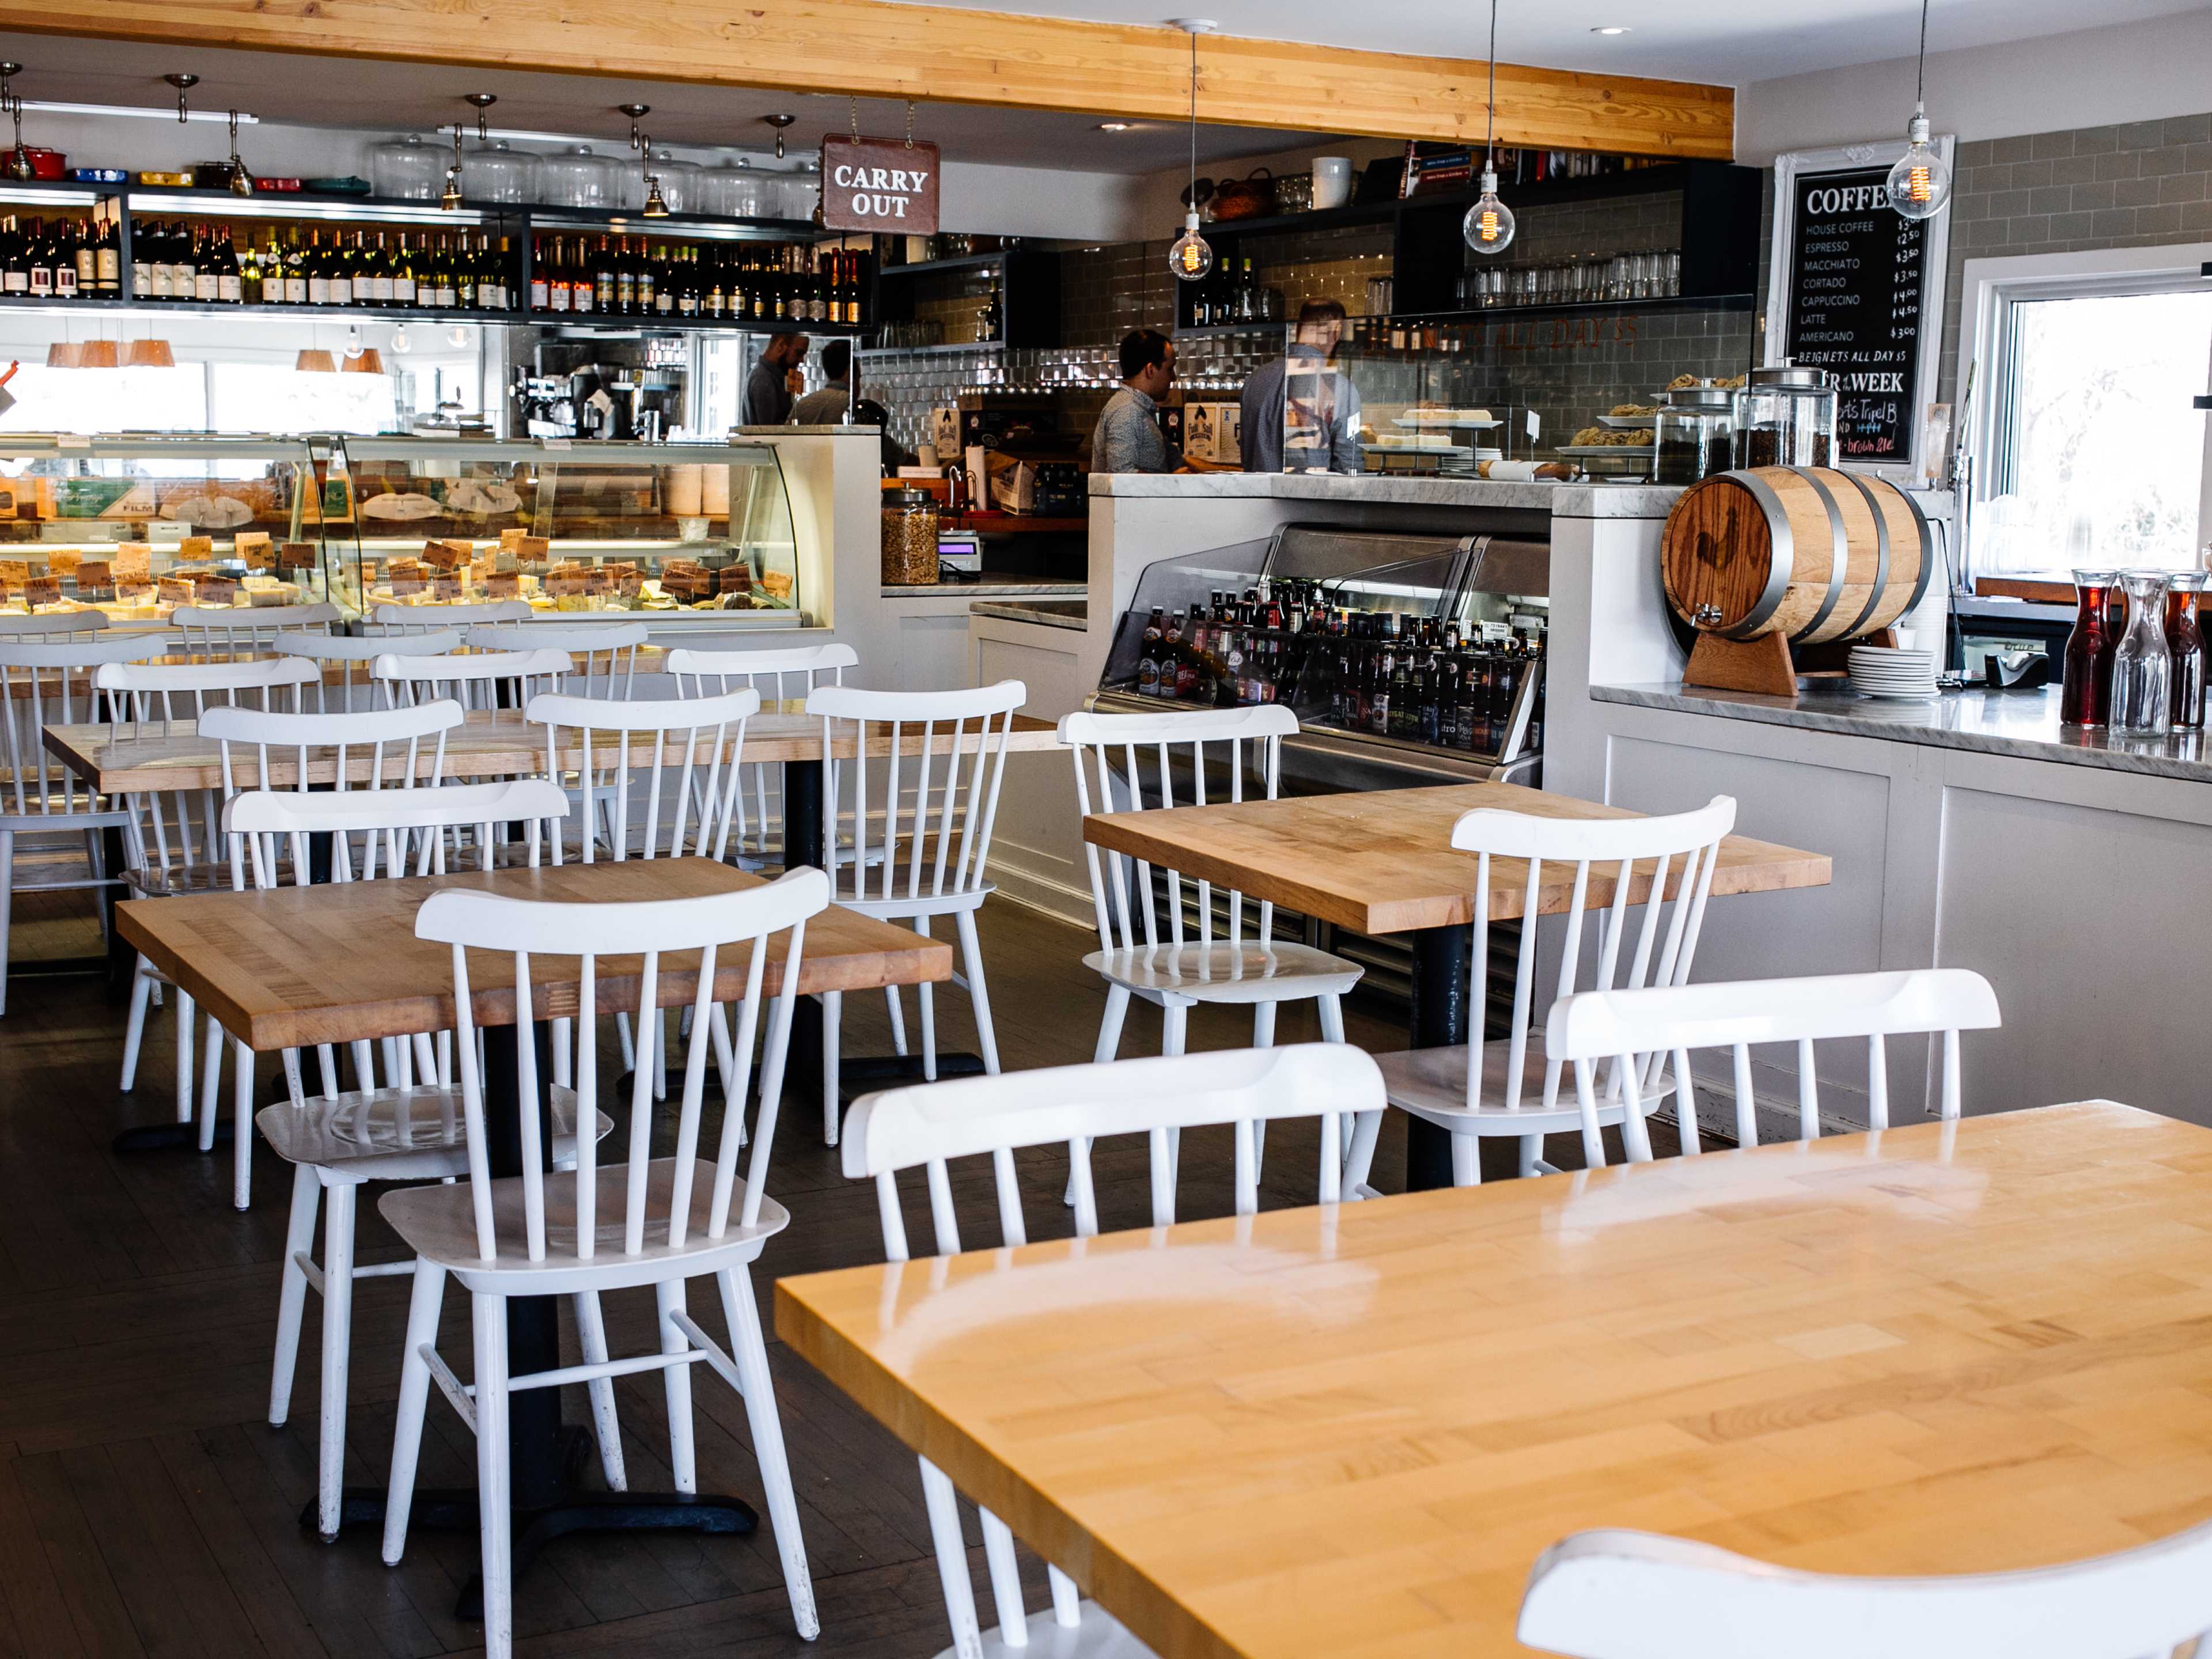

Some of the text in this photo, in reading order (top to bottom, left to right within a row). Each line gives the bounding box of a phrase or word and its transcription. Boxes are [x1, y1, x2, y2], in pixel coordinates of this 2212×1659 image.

[835, 165, 929, 193] CARRY
[852, 193, 909, 218] OUT
[1806, 224, 1836, 235] HOUSE
[1839, 221, 1874, 233] COFFEE
[1805, 241, 1849, 253] ESPRESSO
[1804, 249, 1919, 271] MACCHIATO $3.50
[1803, 270, 1918, 289] CORTADO $3.50
[1802, 289, 1917, 306] CAPPUCCINO $4.00
[1801, 306, 1918, 325] LATTE $4.50
[1550, 317, 1608, 349] DAY
[1799, 331, 1854, 342] AMERICANO
[1798, 350, 1906, 365] BEIGNETS ALL DAY $5
[1850, 373, 1903, 392] WEEK
[1860, 399, 1885, 422] Tripel
[1847, 438, 1874, 453] brown
